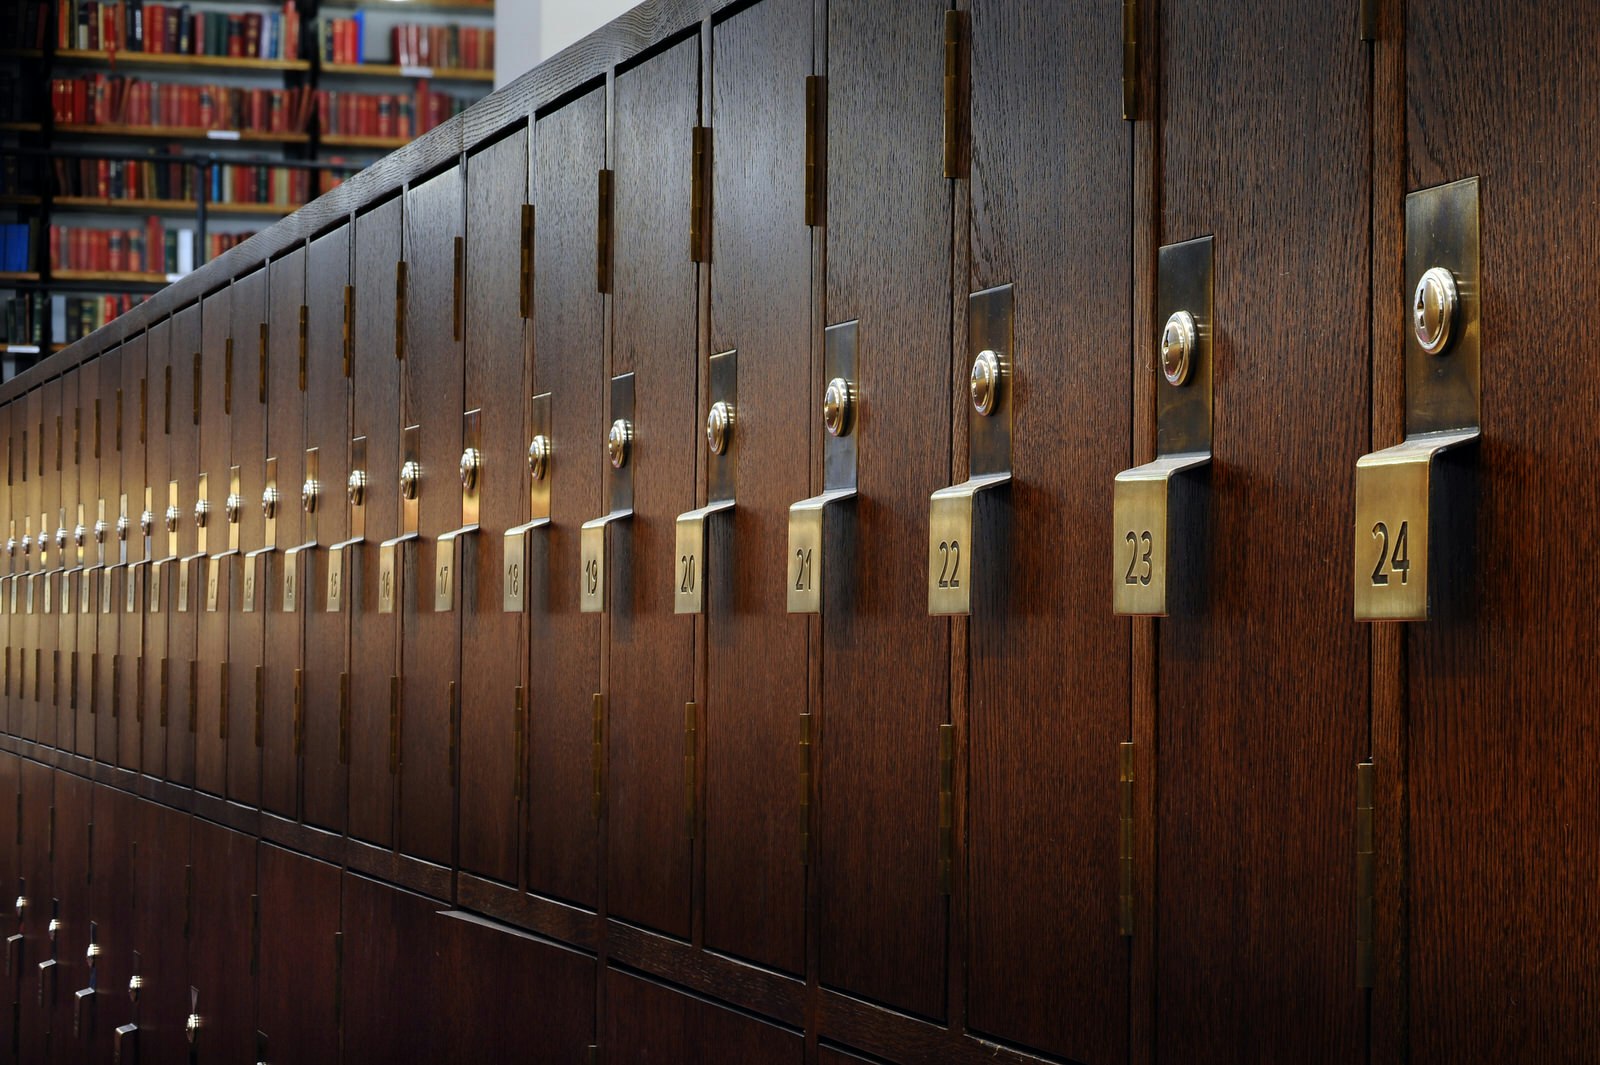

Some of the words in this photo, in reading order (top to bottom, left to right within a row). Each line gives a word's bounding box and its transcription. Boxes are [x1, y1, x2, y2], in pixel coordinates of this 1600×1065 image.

[795, 548, 812, 592] 21
[938, 540, 960, 589] 22
[1125, 529, 1153, 586] 23
[1371, 520, 1410, 586] 24
[382, 570, 391, 600] 16
[439, 566, 449, 598] 17
[508, 563, 519, 598] 18
[585, 559, 598, 596] 19
[680, 554, 696, 594] 20
